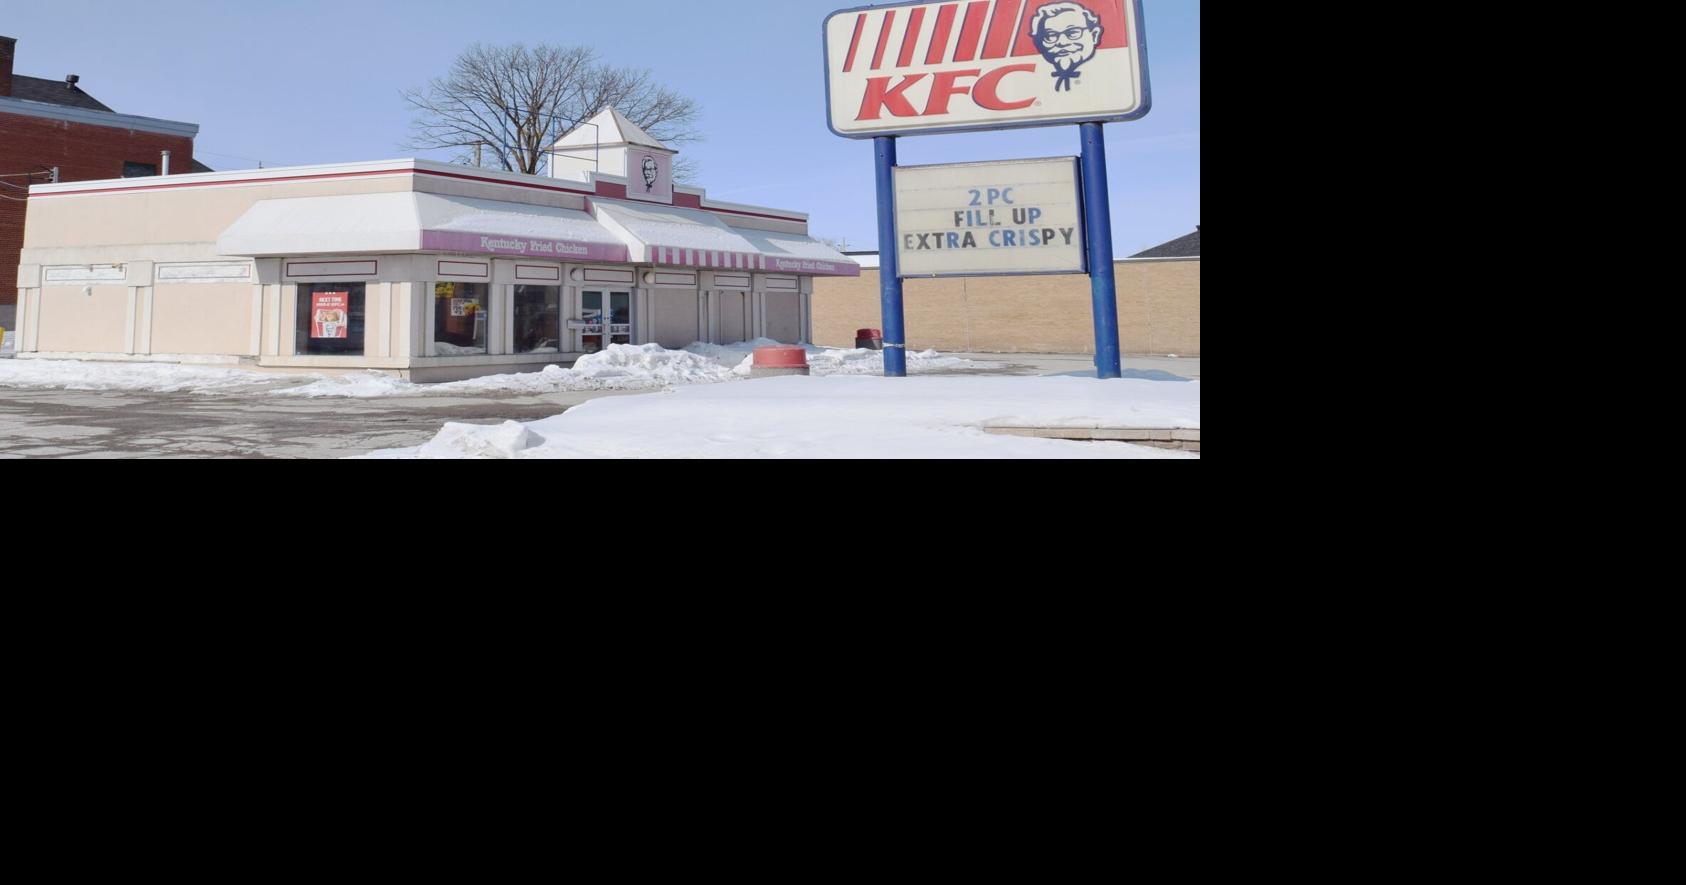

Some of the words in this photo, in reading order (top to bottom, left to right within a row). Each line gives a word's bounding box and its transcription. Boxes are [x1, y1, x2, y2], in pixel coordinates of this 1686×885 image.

[854, 63, 1037, 121] KFC
[968, 189, 982, 206] 2
[987, 187, 1014, 205] PC
[954, 209, 1001, 227] FILL
[1012, 207, 1042, 225] UP
[480, 236, 527, 253] Kentucky
[530, 240, 553, 252] Fried
[556, 242, 588, 255] Chicken
[903, 231, 977, 250] EXTRA
[988, 227, 1074, 247] CRISPY
